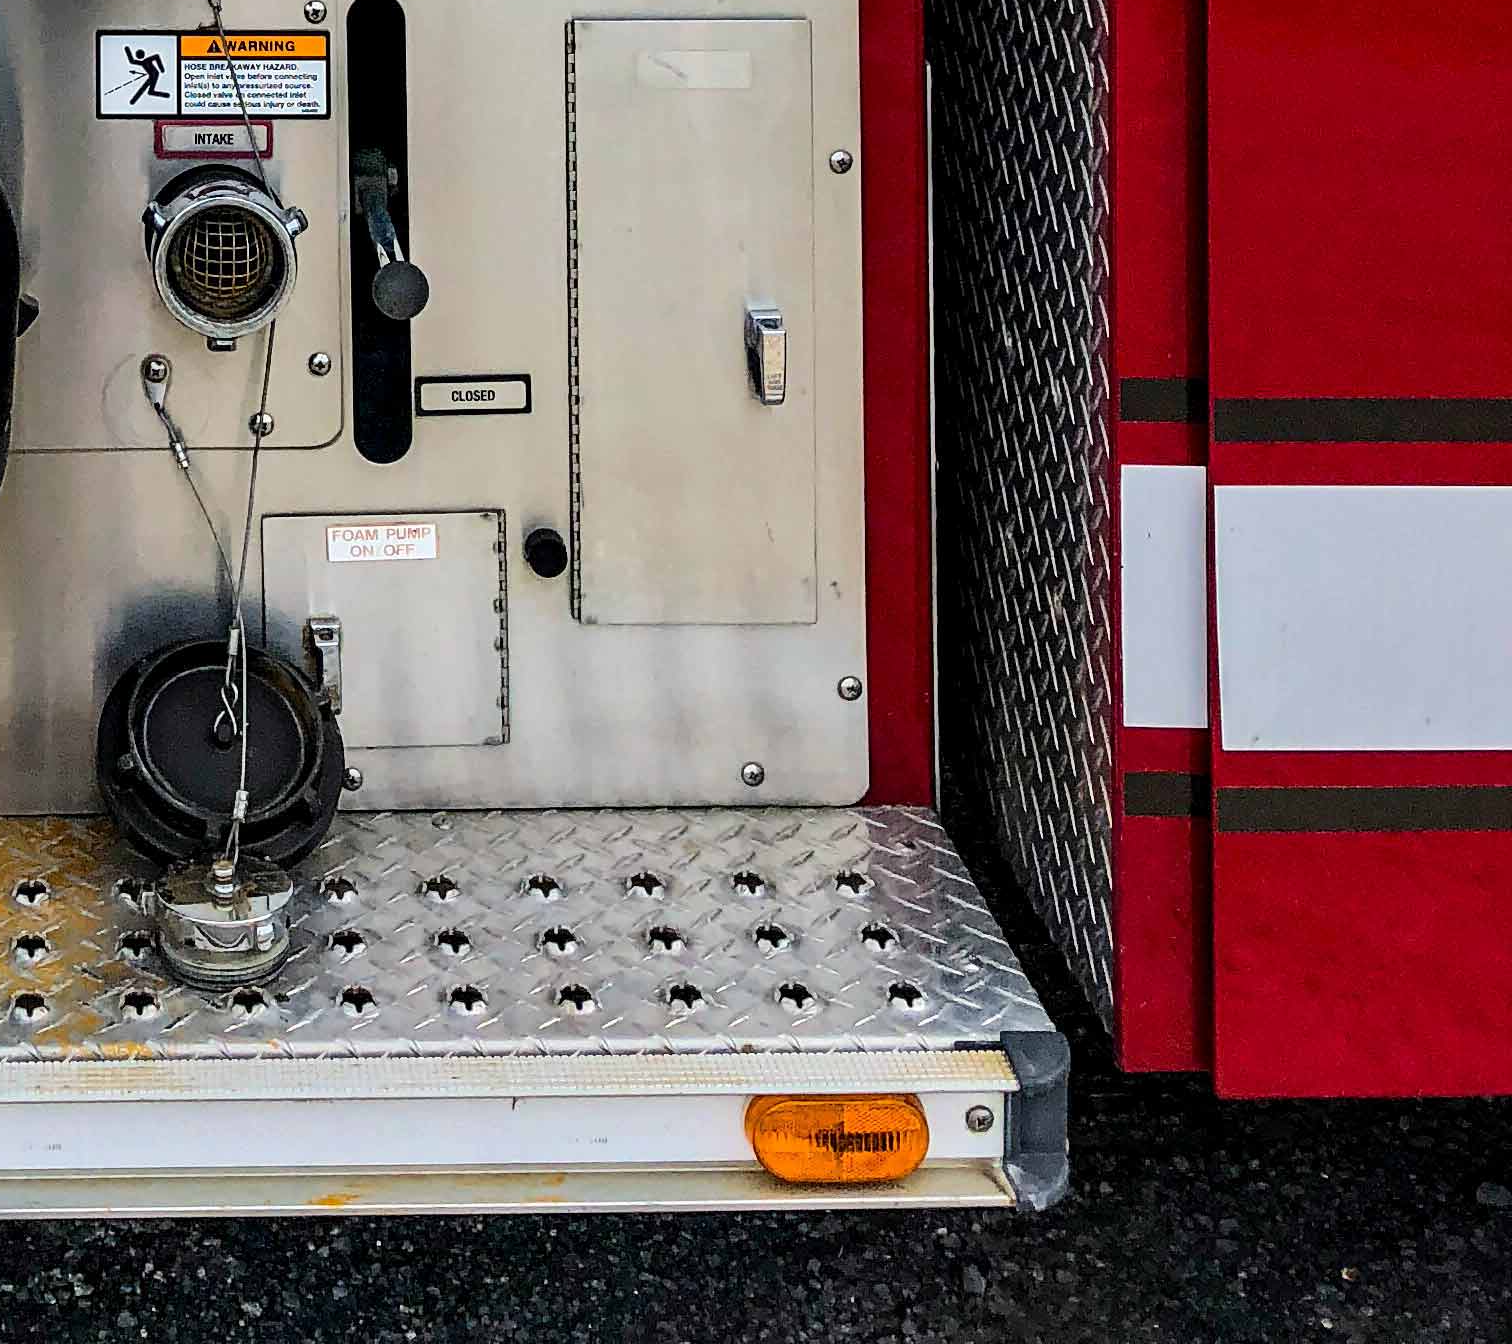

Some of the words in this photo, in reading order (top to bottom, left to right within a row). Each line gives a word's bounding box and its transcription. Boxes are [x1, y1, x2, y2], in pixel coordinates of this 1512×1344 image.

[224, 40, 295, 52] WARNING
[184, 63, 207, 71] HOSE
[209, 63, 261, 71] BREAKAWAY
[184, 73, 205, 81] Open
[207, 72, 223, 80] inlet
[247, 72, 273, 80] before
[274, 73, 318, 82] connecting
[184, 91, 212, 99] Closed
[246, 91, 288, 99] connected
[289, 91, 307, 99] inlet
[184, 100, 206, 108] could
[232, 100, 262, 108] seious
[263, 100, 285, 109] injury
[194, 133, 235, 145] INTAKE
[451, 389, 496, 402] CLOSED
[332, 529, 379, 542] FOAM
[386, 527, 431, 540] PUMP
